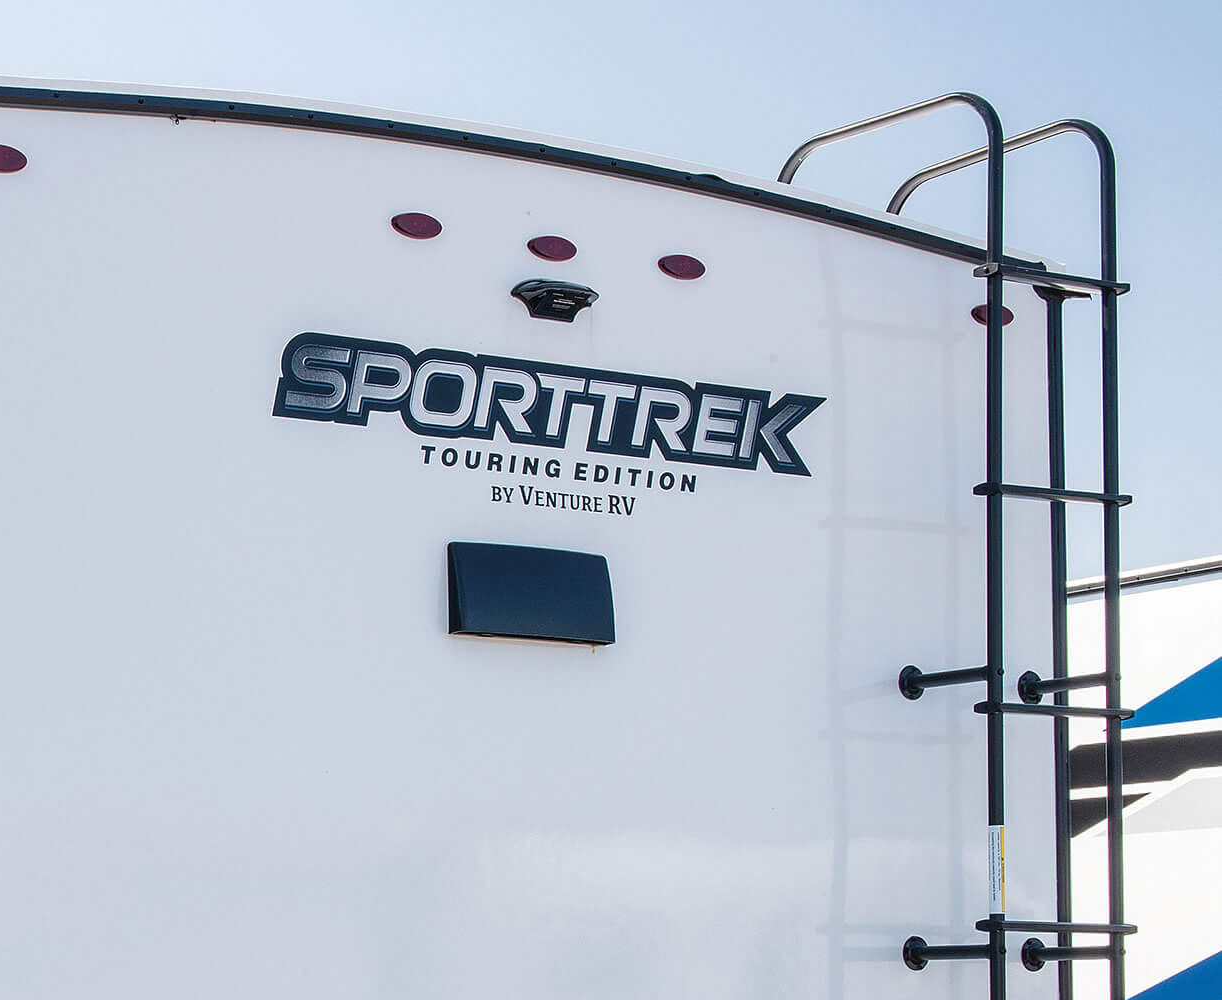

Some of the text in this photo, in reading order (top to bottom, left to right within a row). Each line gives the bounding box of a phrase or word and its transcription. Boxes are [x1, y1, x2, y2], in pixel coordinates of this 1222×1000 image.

[272, 332, 827, 477] SPORTTREK
[420, 445, 697, 493] TOURING EDITION
[491, 486, 514, 504] BY
[608, 495, 636, 516] RV
